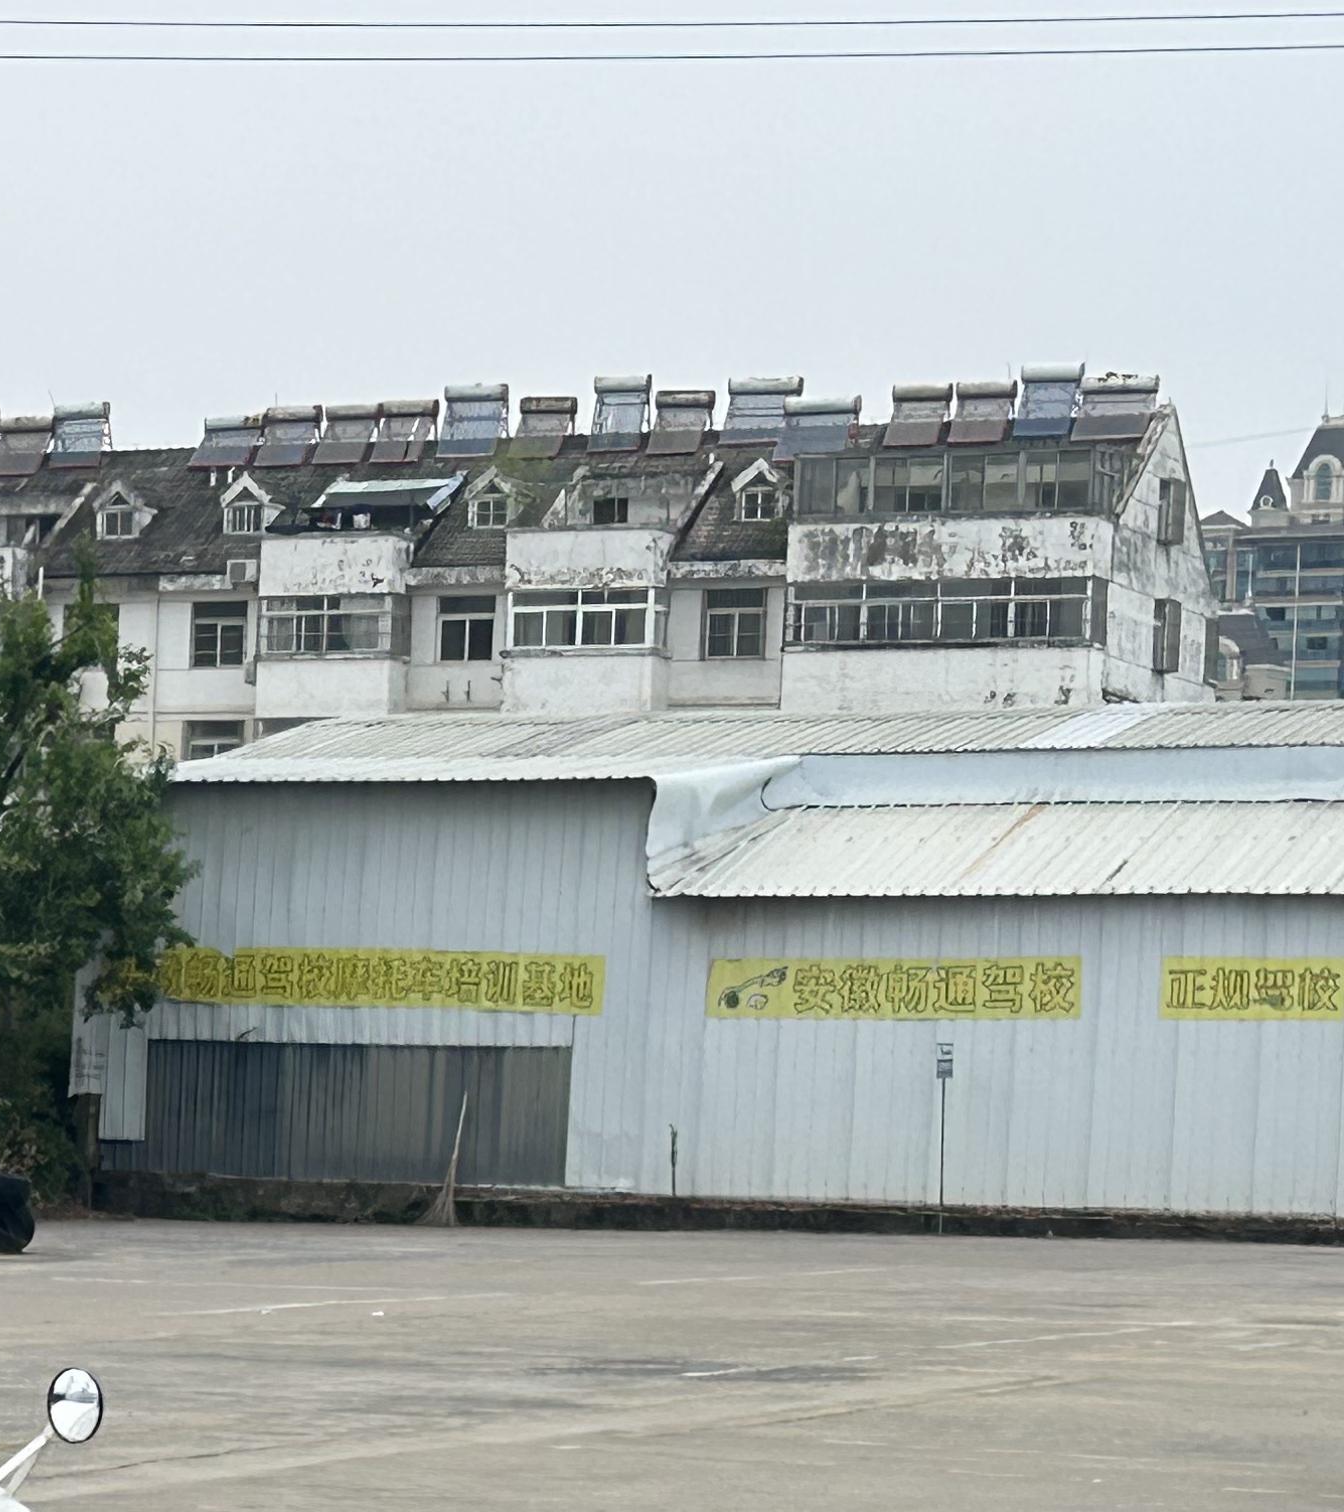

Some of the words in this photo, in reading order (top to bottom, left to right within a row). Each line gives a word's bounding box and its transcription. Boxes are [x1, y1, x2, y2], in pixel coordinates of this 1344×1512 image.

[793, 962, 1075, 1015] 安徽畅通驾校
[1165, 966, 1341, 1012] 正规驾校
